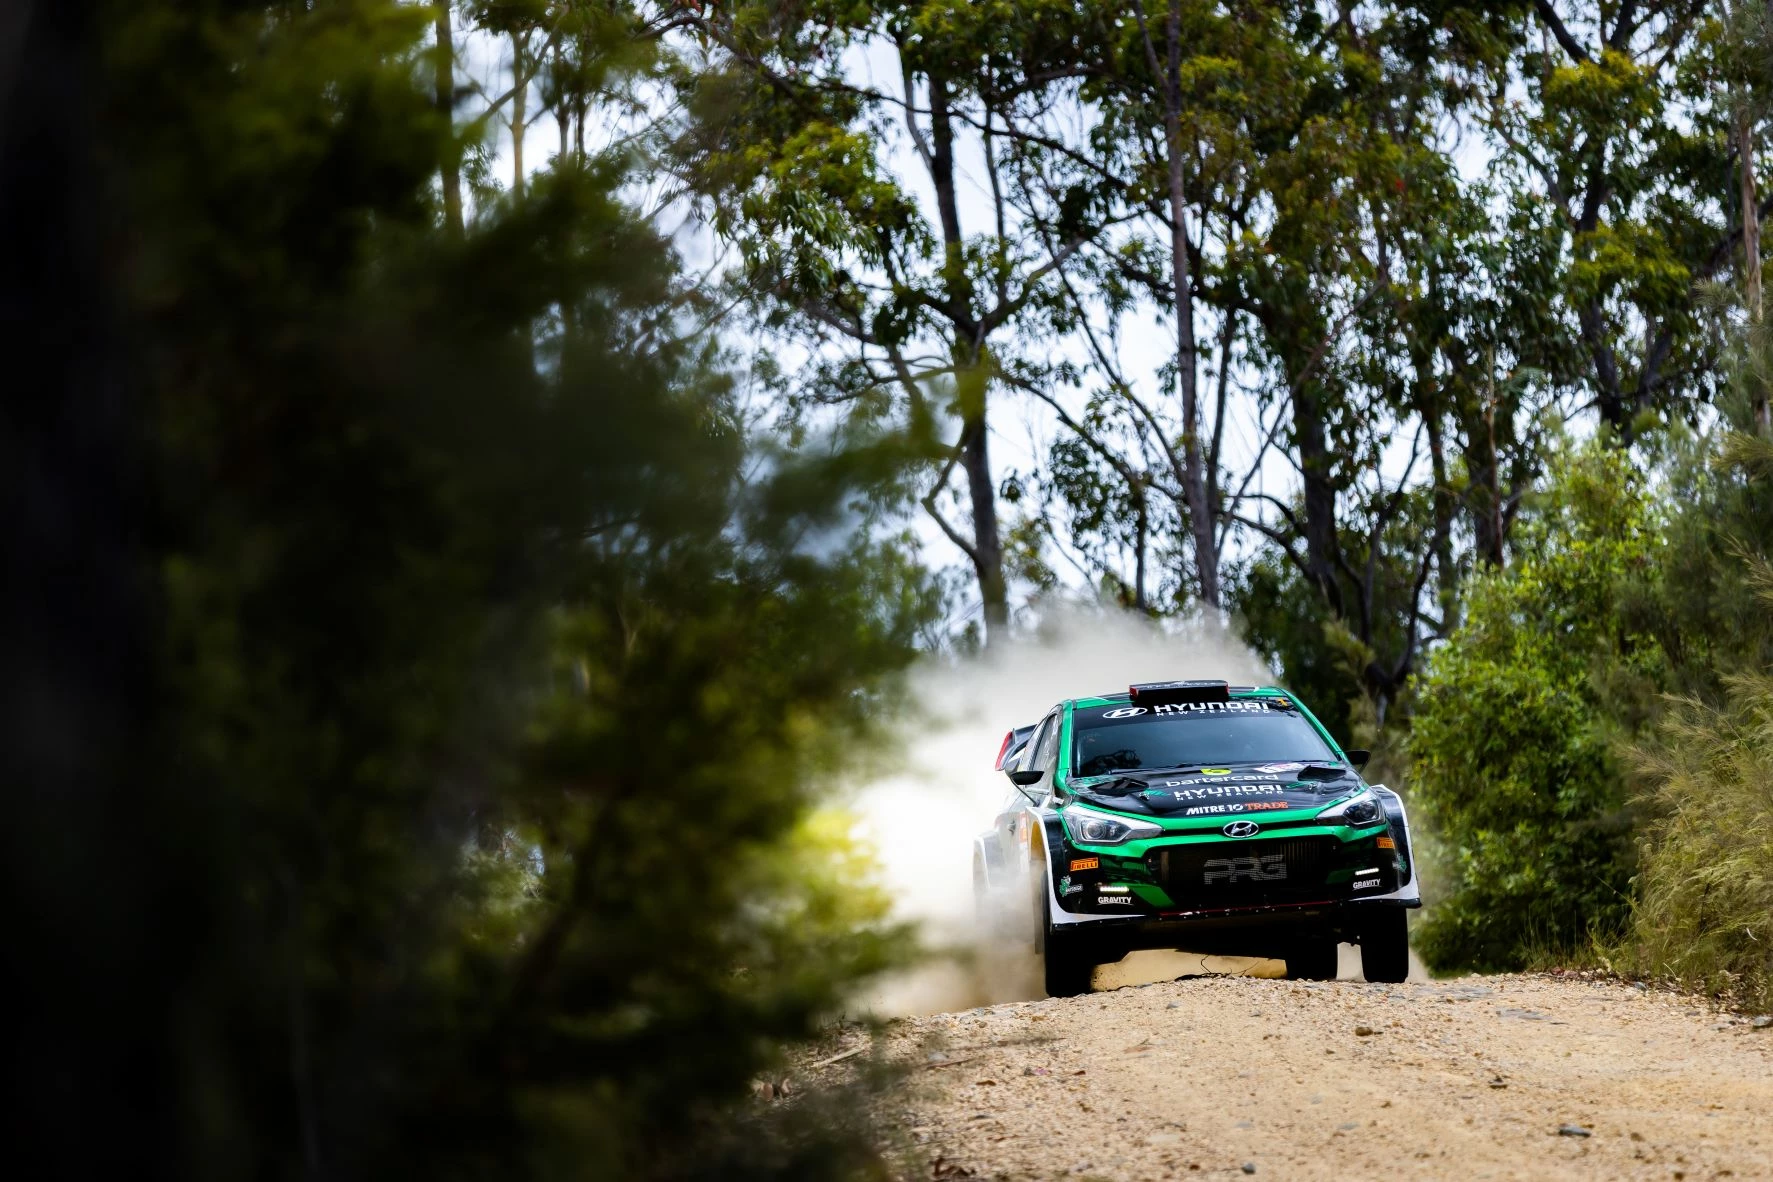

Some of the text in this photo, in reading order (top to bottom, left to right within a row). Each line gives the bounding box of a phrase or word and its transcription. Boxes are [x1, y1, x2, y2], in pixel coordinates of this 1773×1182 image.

[1153, 701, 1269, 713] HYUNDAI
[1165, 774, 1279, 787] bartercard
[1174, 784, 1283, 797] HYUNDAI
[1185, 801, 1289, 816] MITRE 10 TRADE
[1071, 857, 1098, 870] PIRELLI
[1203, 854, 1287, 884] PRG
[1353, 879, 1381, 889] GRAVITY
[1097, 896, 1132, 904] GRAVITY
